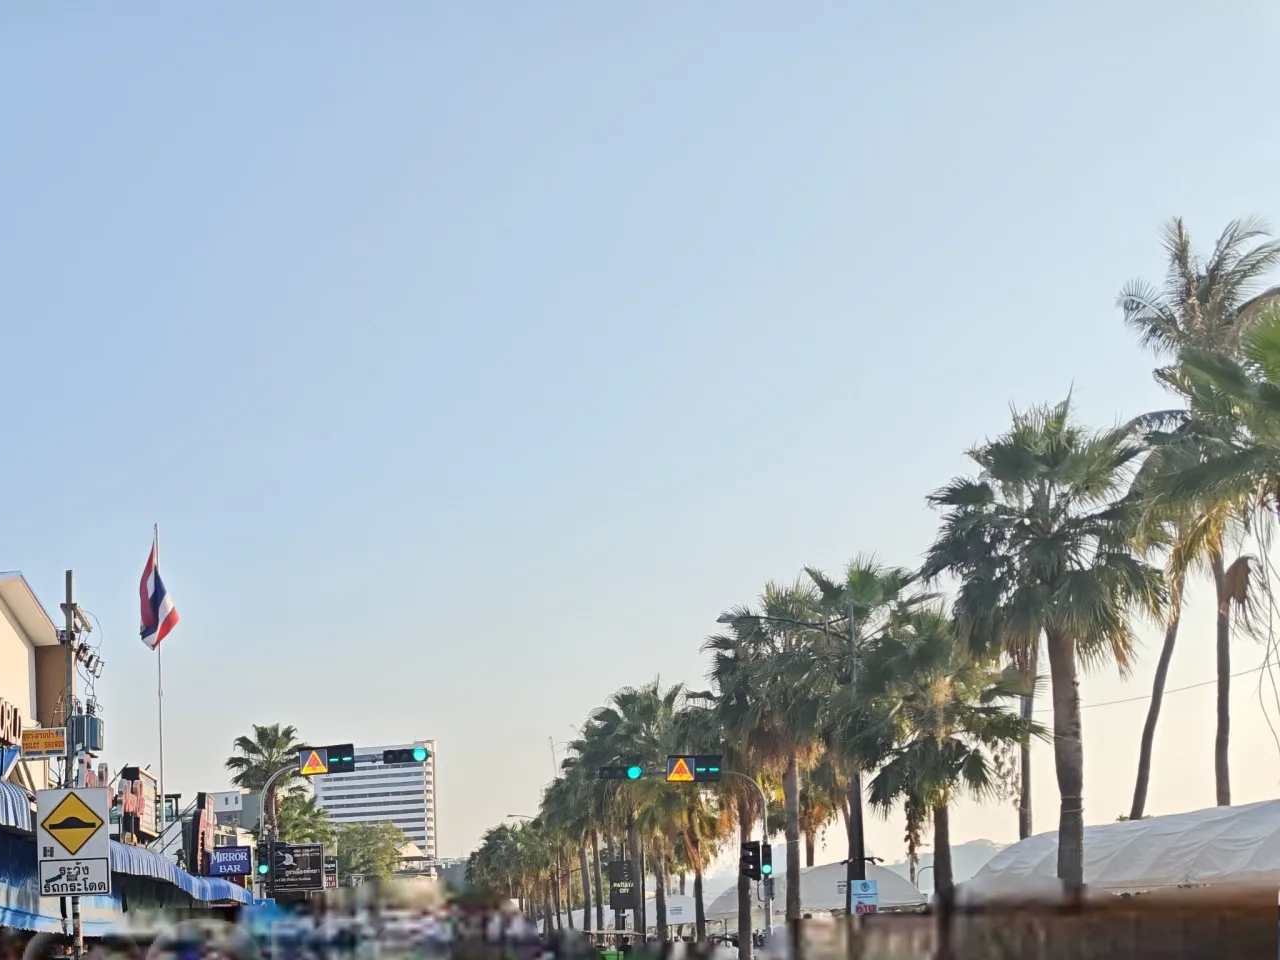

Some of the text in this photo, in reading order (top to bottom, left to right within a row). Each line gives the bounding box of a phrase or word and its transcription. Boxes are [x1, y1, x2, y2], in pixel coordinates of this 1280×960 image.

[210, 851, 248, 865] MIRROR
[59, 861, 90, 876] ระวัง
[219, 864, 242, 873] BAR
[43, 877, 107, 893] รถกระโดด
